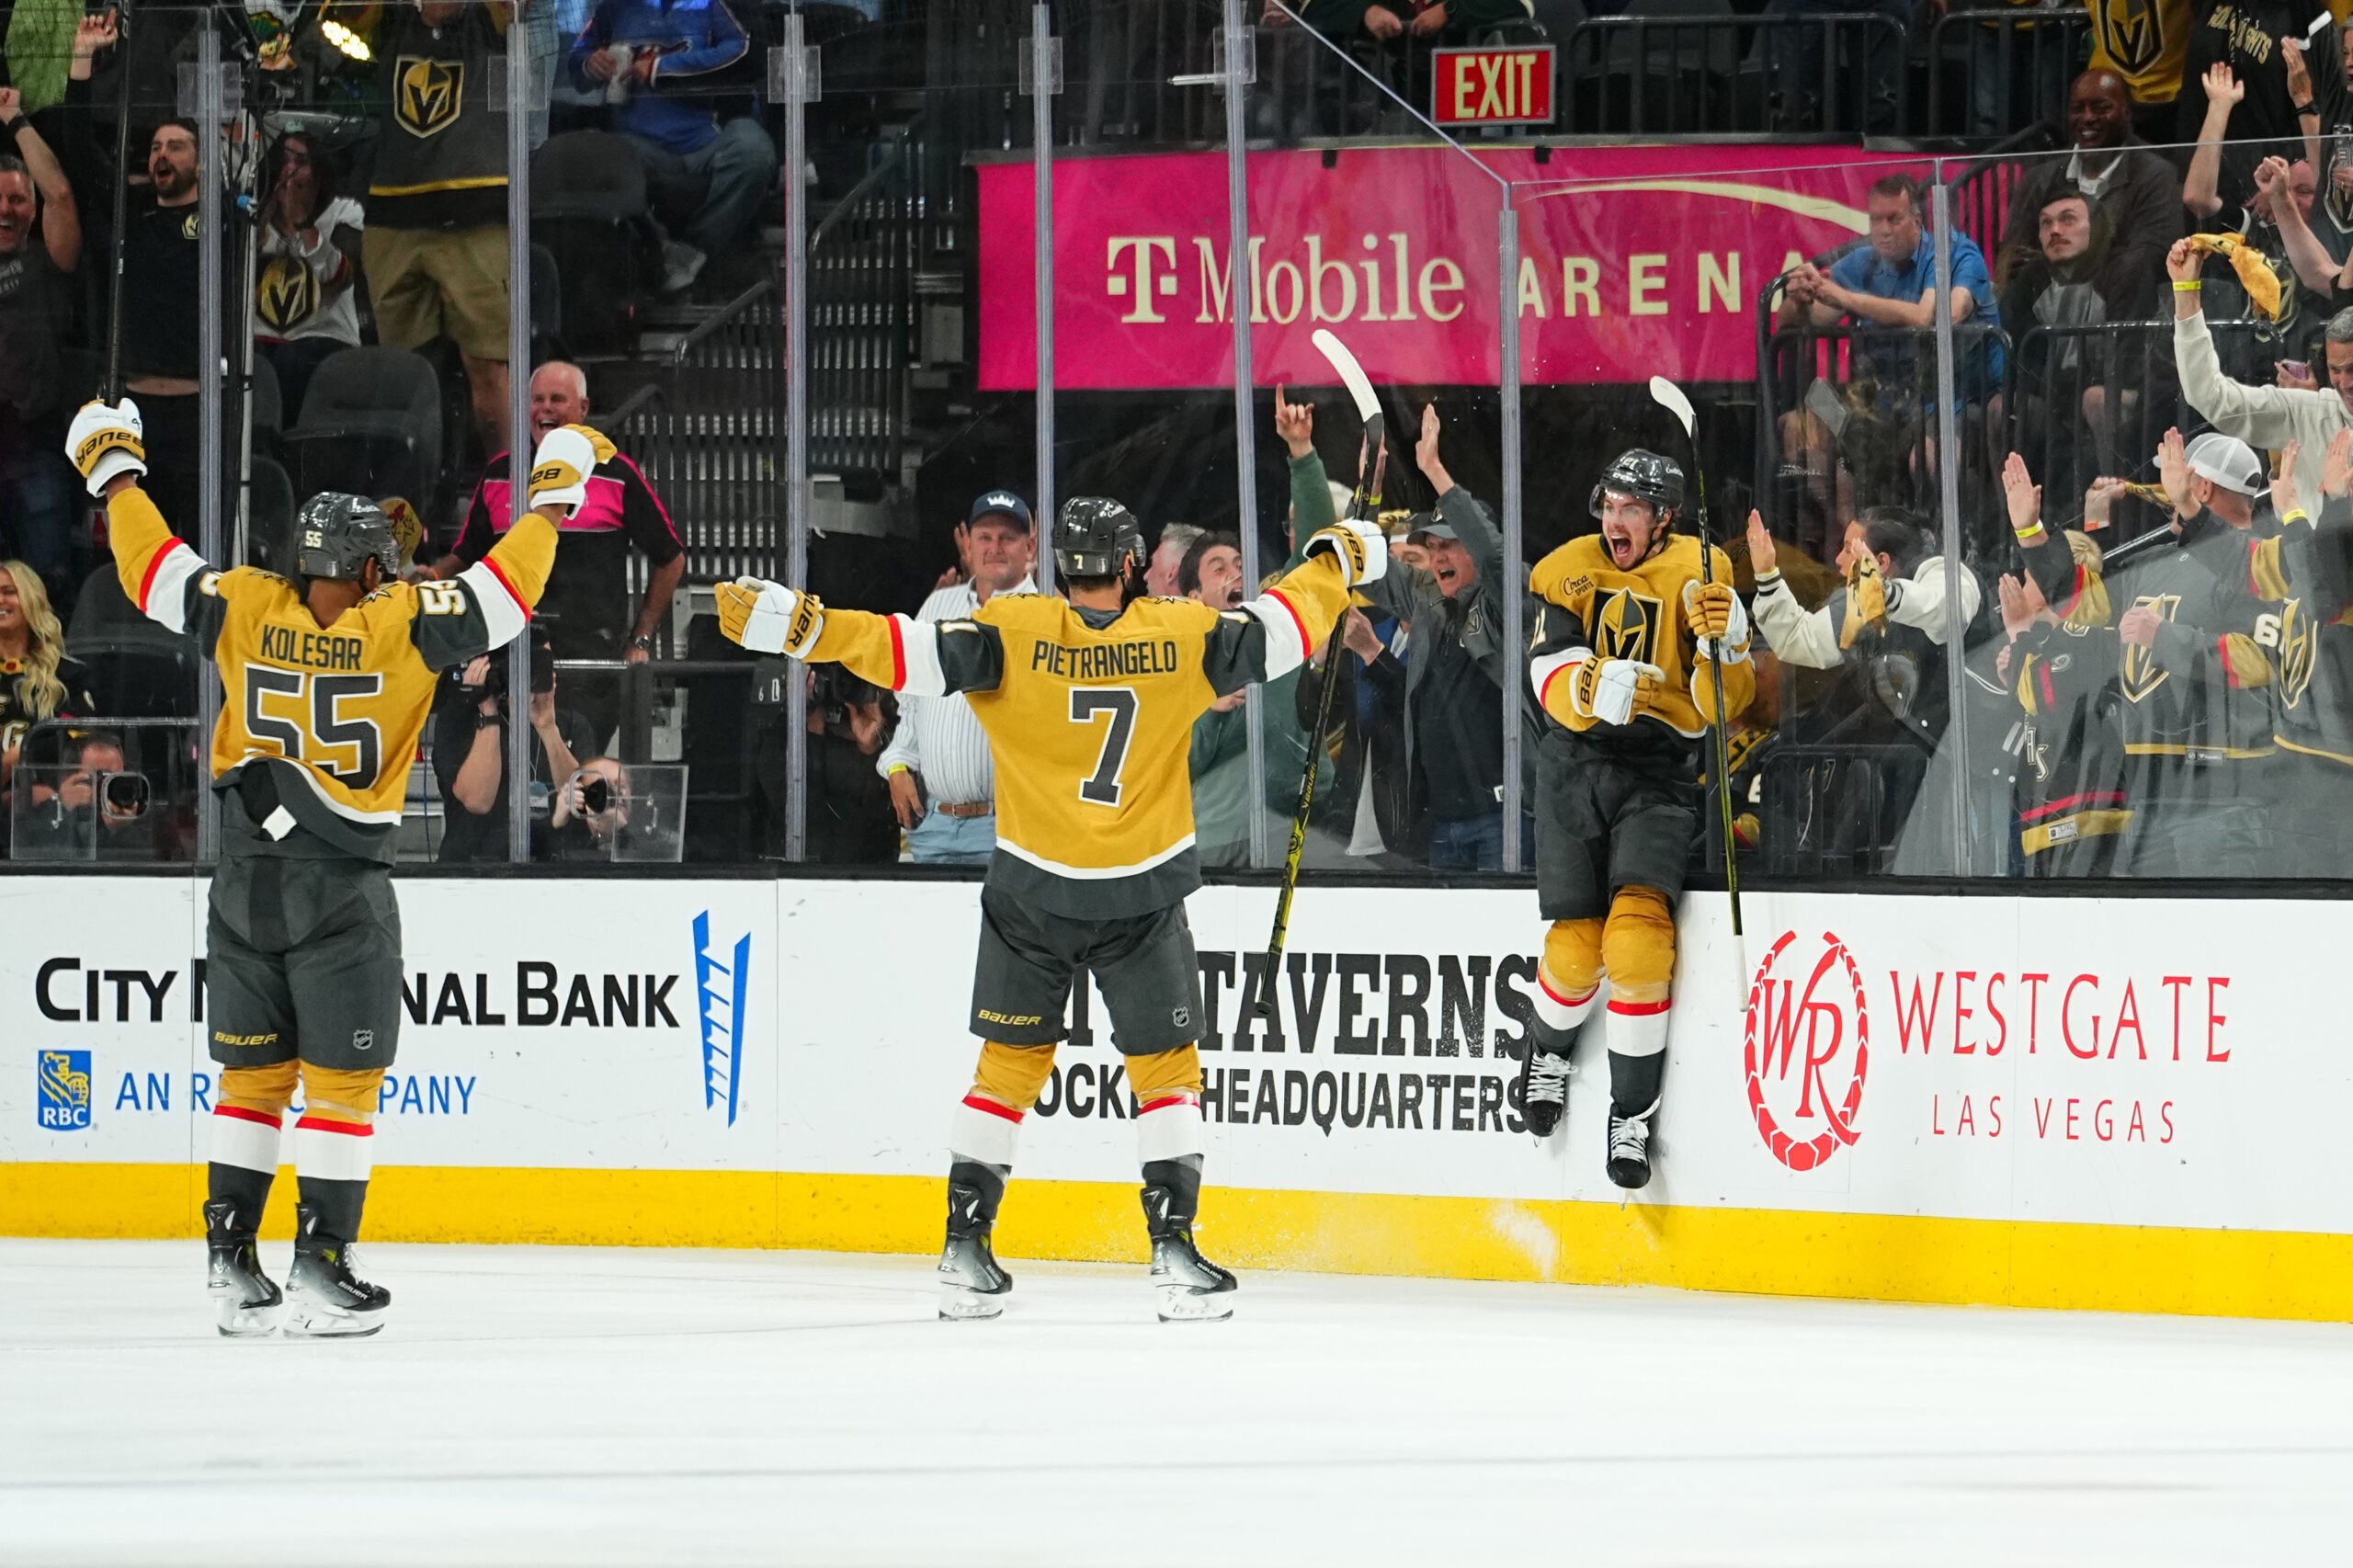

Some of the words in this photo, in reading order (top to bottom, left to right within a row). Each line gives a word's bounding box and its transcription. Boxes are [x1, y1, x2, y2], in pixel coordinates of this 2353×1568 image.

[1455, 54, 1537, 119] EXIT
[304, 529, 323, 548] 55
[1074, 554, 1083, 570] 7
[1563, 574, 1589, 596] Circa
[261, 624, 362, 671] KOLESAR
[1031, 640, 1176, 678] PIETRANGELO
[1580, 657, 1598, 705] BAU
[244, 662, 383, 791] 55
[1068, 687, 1140, 808] 7
[1197, 951, 1539, 1061] TAVERNS
[1890, 971, 2232, 1062] WESTGATE
[116, 1073, 169, 1110] AN
[1033, 1063, 1139, 1119] OCK
[1199, 1068, 1529, 1137] HEADQUARTERS
[43, 1106, 87, 1127] RBC
[1933, 1094, 2001, 1137] LAS
[2034, 1097, 2174, 1143] VEGAS
